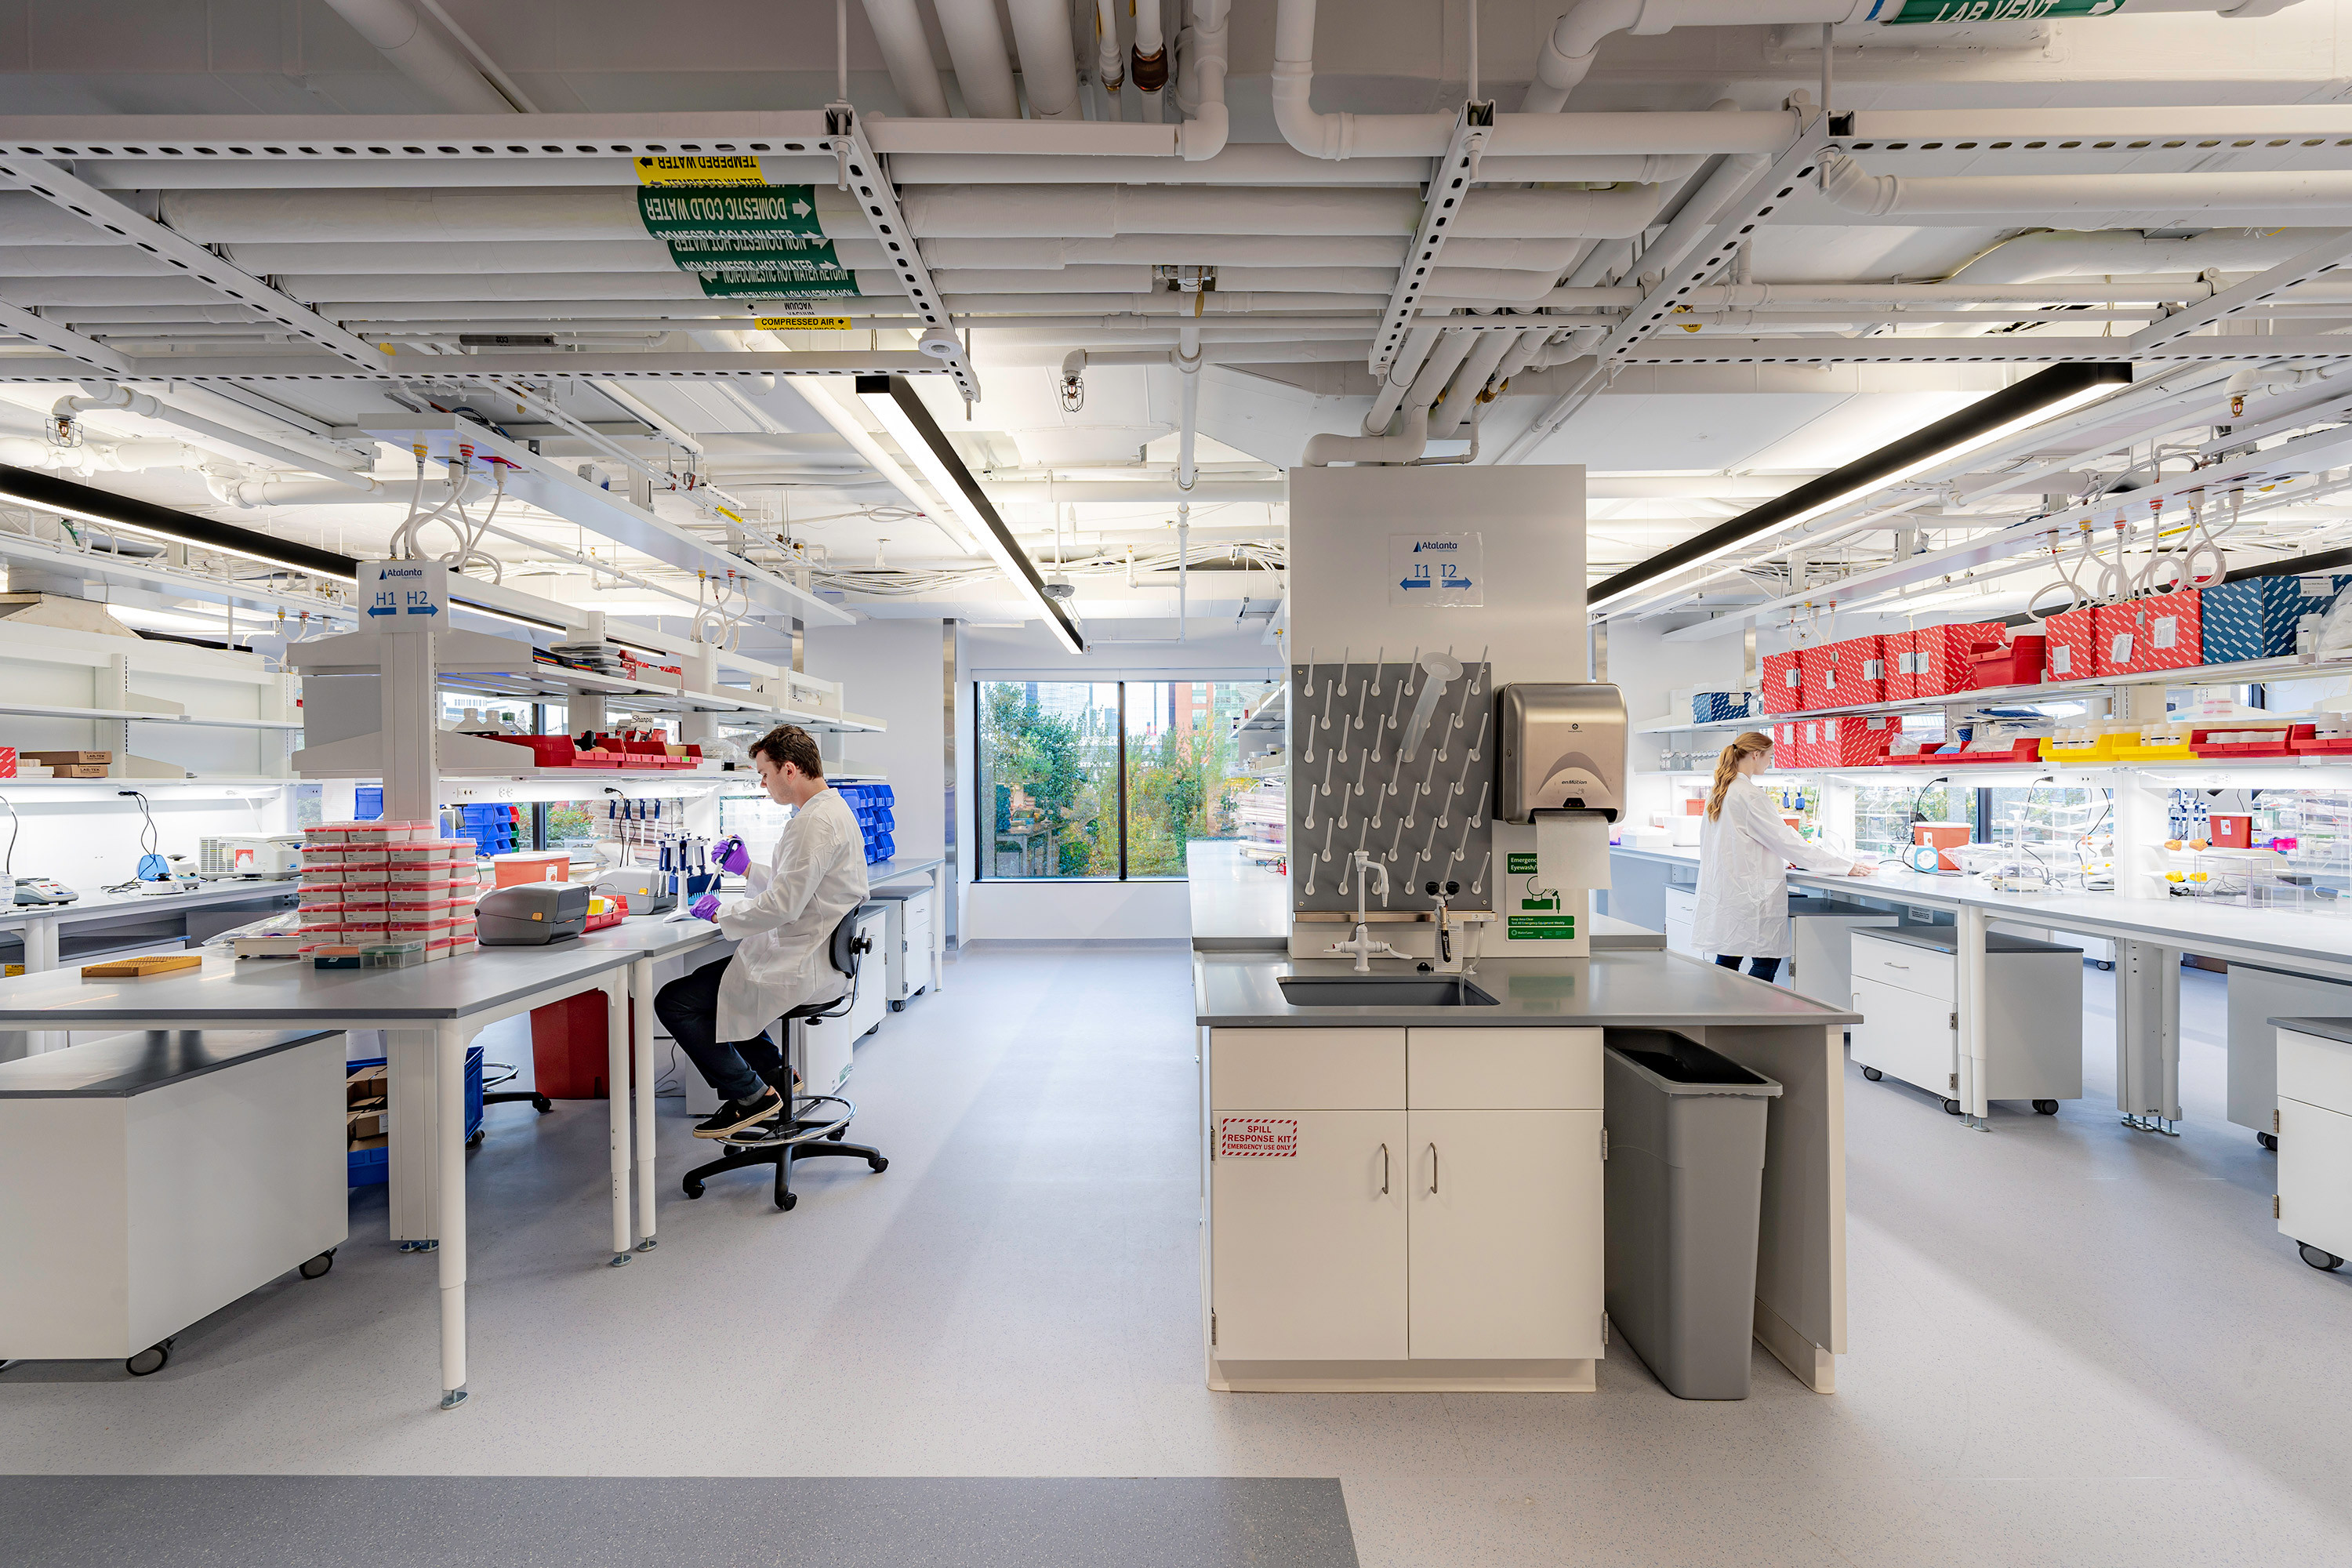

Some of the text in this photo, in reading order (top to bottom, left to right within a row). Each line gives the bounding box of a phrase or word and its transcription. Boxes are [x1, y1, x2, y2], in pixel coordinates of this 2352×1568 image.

[1930, 0, 2060, 24] LAB VENT
[657, 156, 757, 169] TEMPERED WATER
[644, 198, 788, 221] DOMESTIC COLD WATER
[777, 260, 816, 270] WATER
[387, 568, 423, 577] Atalanta
[376, 590, 428, 606] H1 H2
[631, 714, 654, 724] Sharpie
